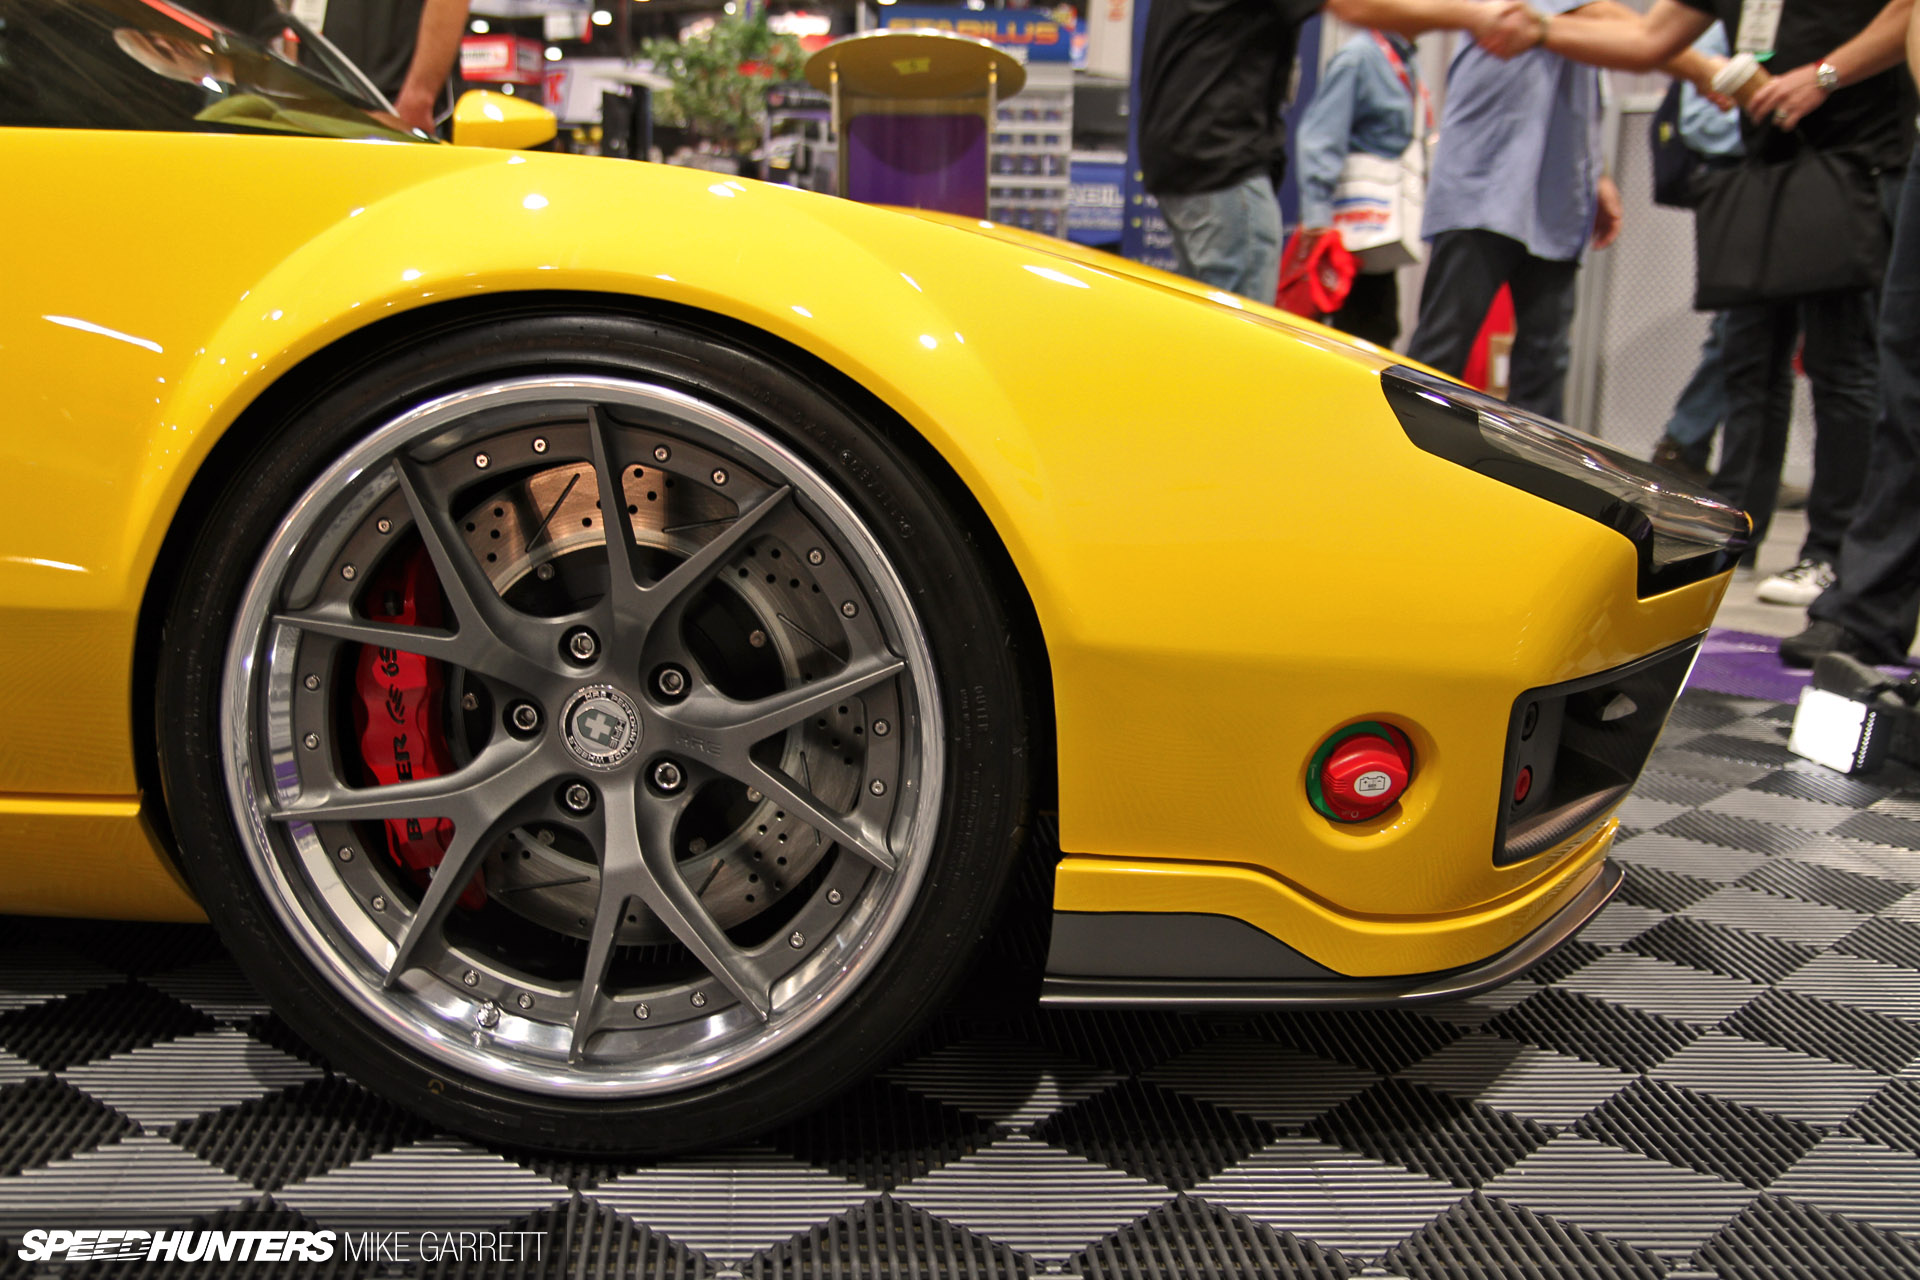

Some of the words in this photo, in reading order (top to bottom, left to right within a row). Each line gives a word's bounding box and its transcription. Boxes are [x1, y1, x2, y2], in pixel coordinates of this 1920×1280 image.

[568, 735, 605, 764] WHEELS
[608, 694, 638, 762] PERFORMANCE
[393, 733, 424, 842] BER
